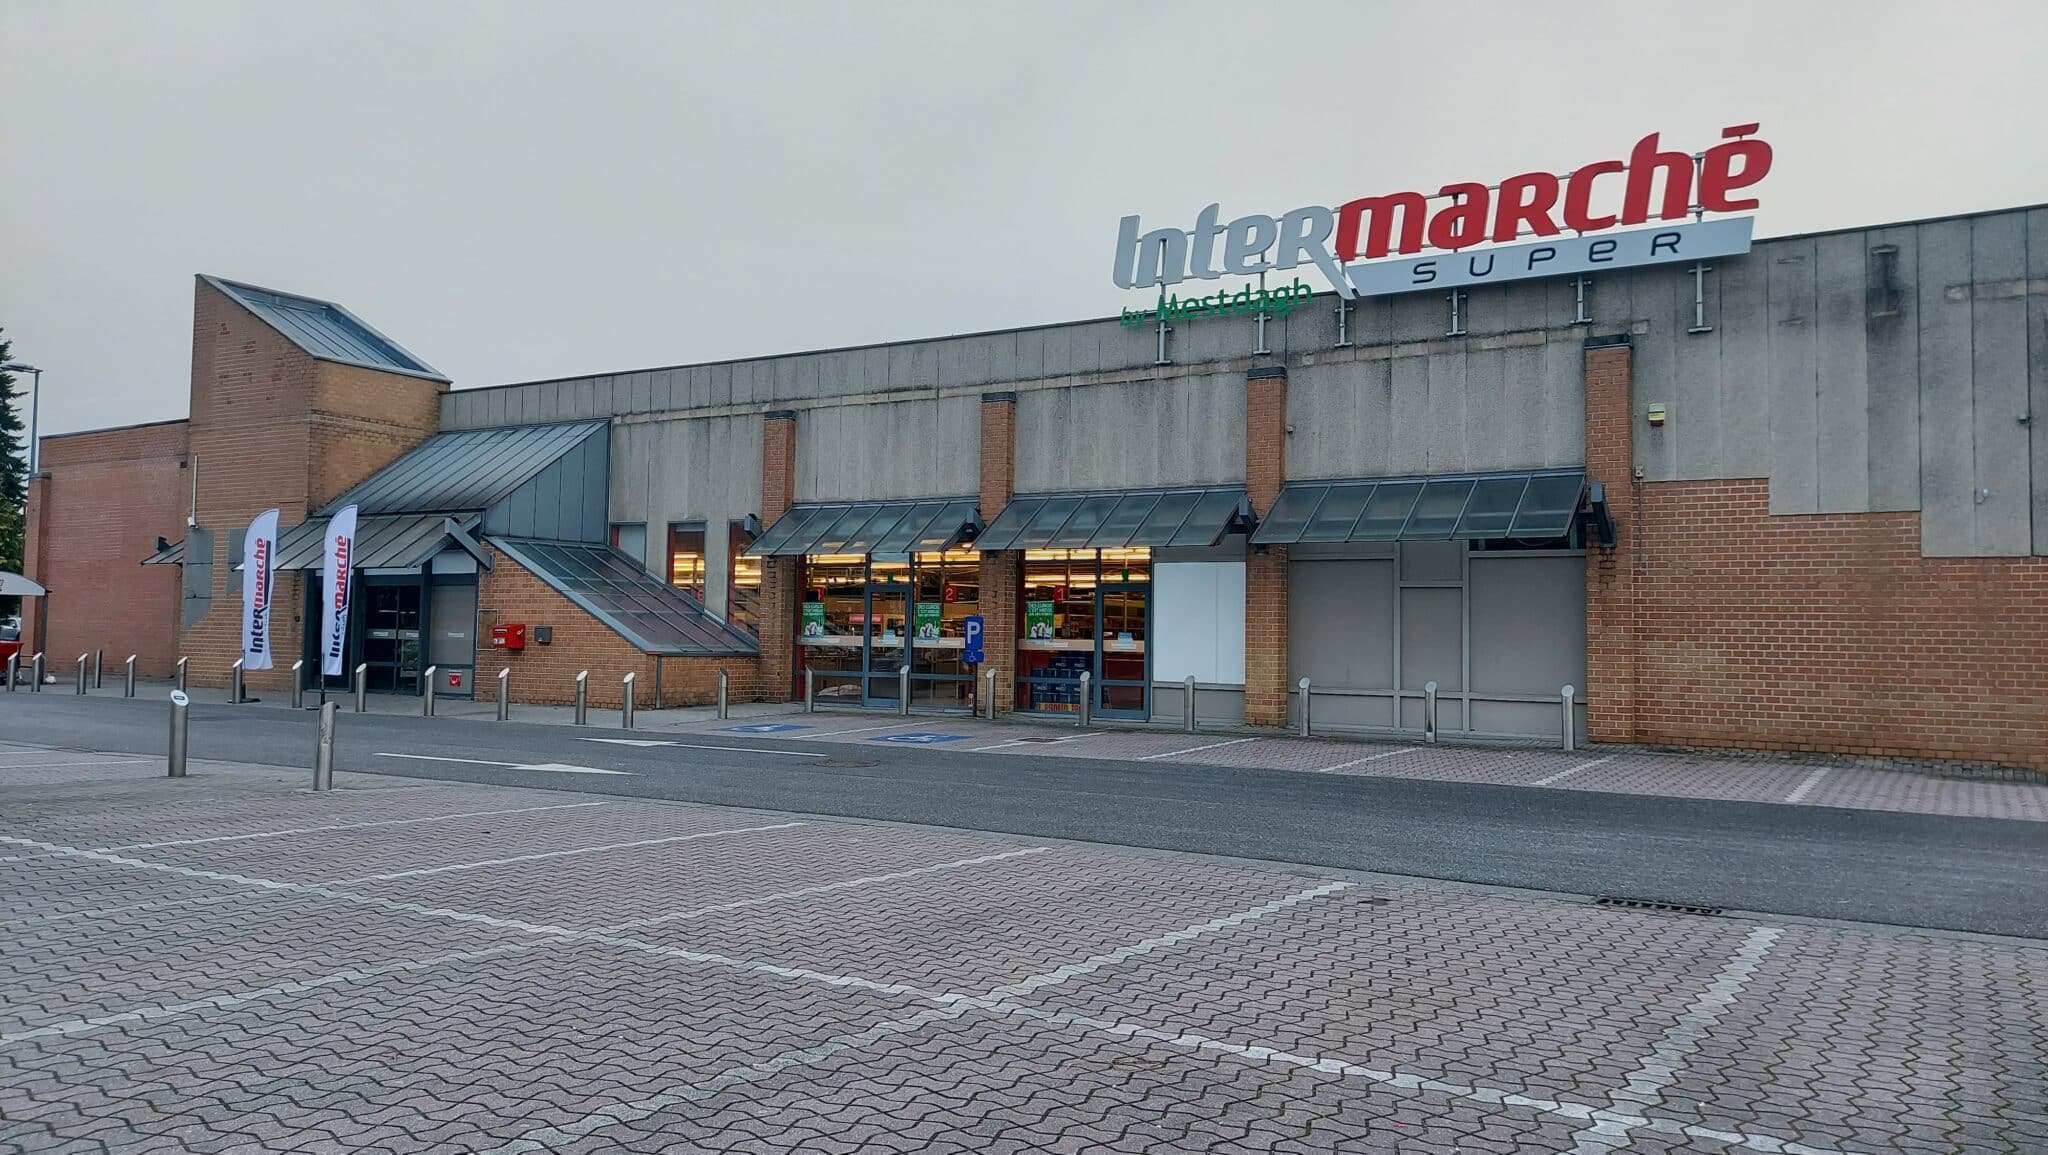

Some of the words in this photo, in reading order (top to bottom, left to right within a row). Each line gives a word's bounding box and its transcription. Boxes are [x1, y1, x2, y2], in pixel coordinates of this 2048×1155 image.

[1411, 231, 1682, 285] SUPER
[1120, 306, 1149, 330] by
[1154, 277, 1313, 322] Mestdagh
[945, 587, 954, 601] 2
[967, 621, 980, 644] P
